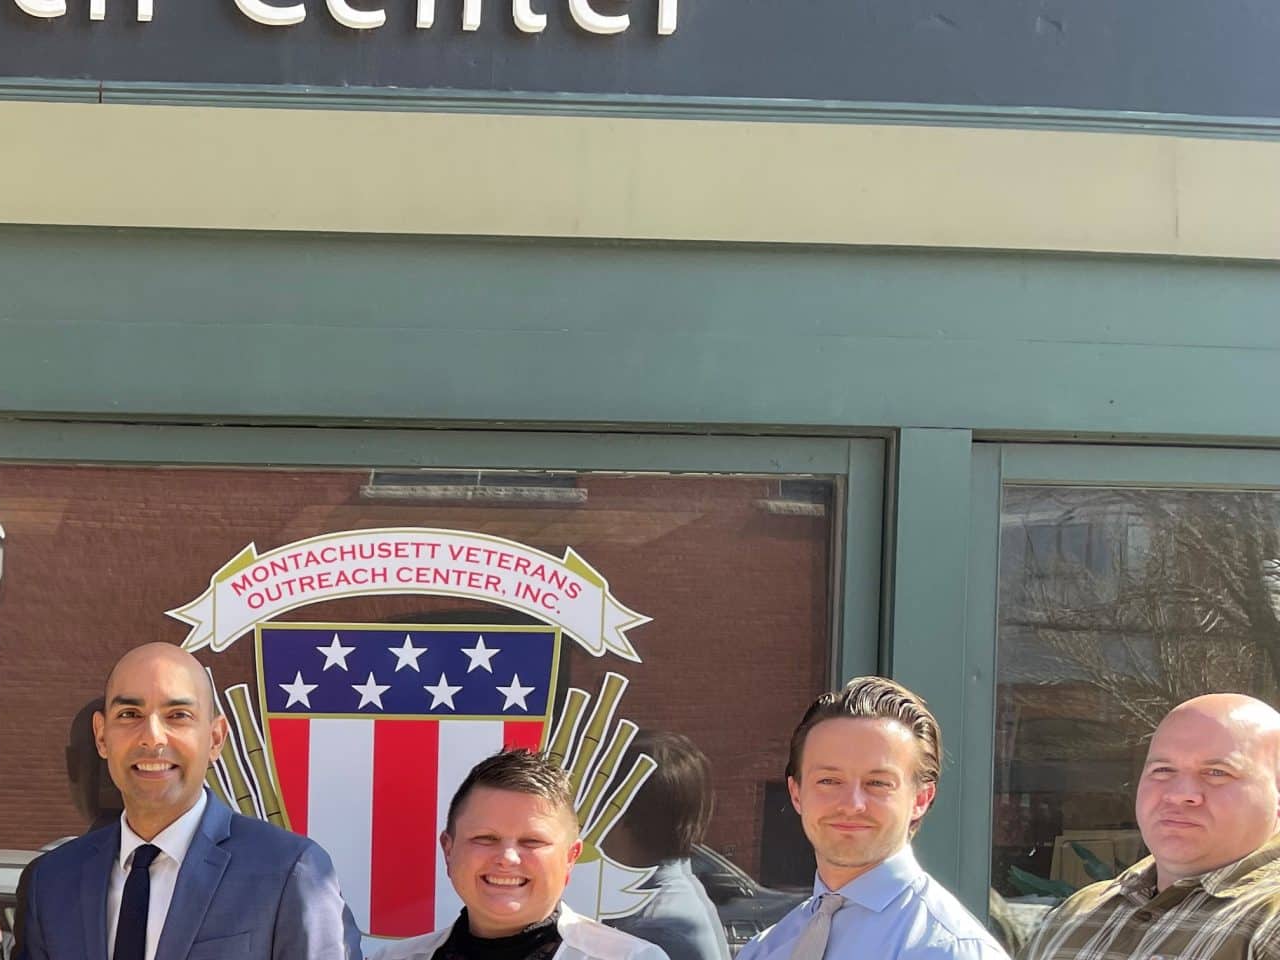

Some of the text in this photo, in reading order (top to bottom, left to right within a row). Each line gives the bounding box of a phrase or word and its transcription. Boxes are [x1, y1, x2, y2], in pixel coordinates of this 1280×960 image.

[231, 541, 583, 600] MONTACHUSETT VETERANS
[247, 566, 562, 615] OUTREACH CENTER, INC.
